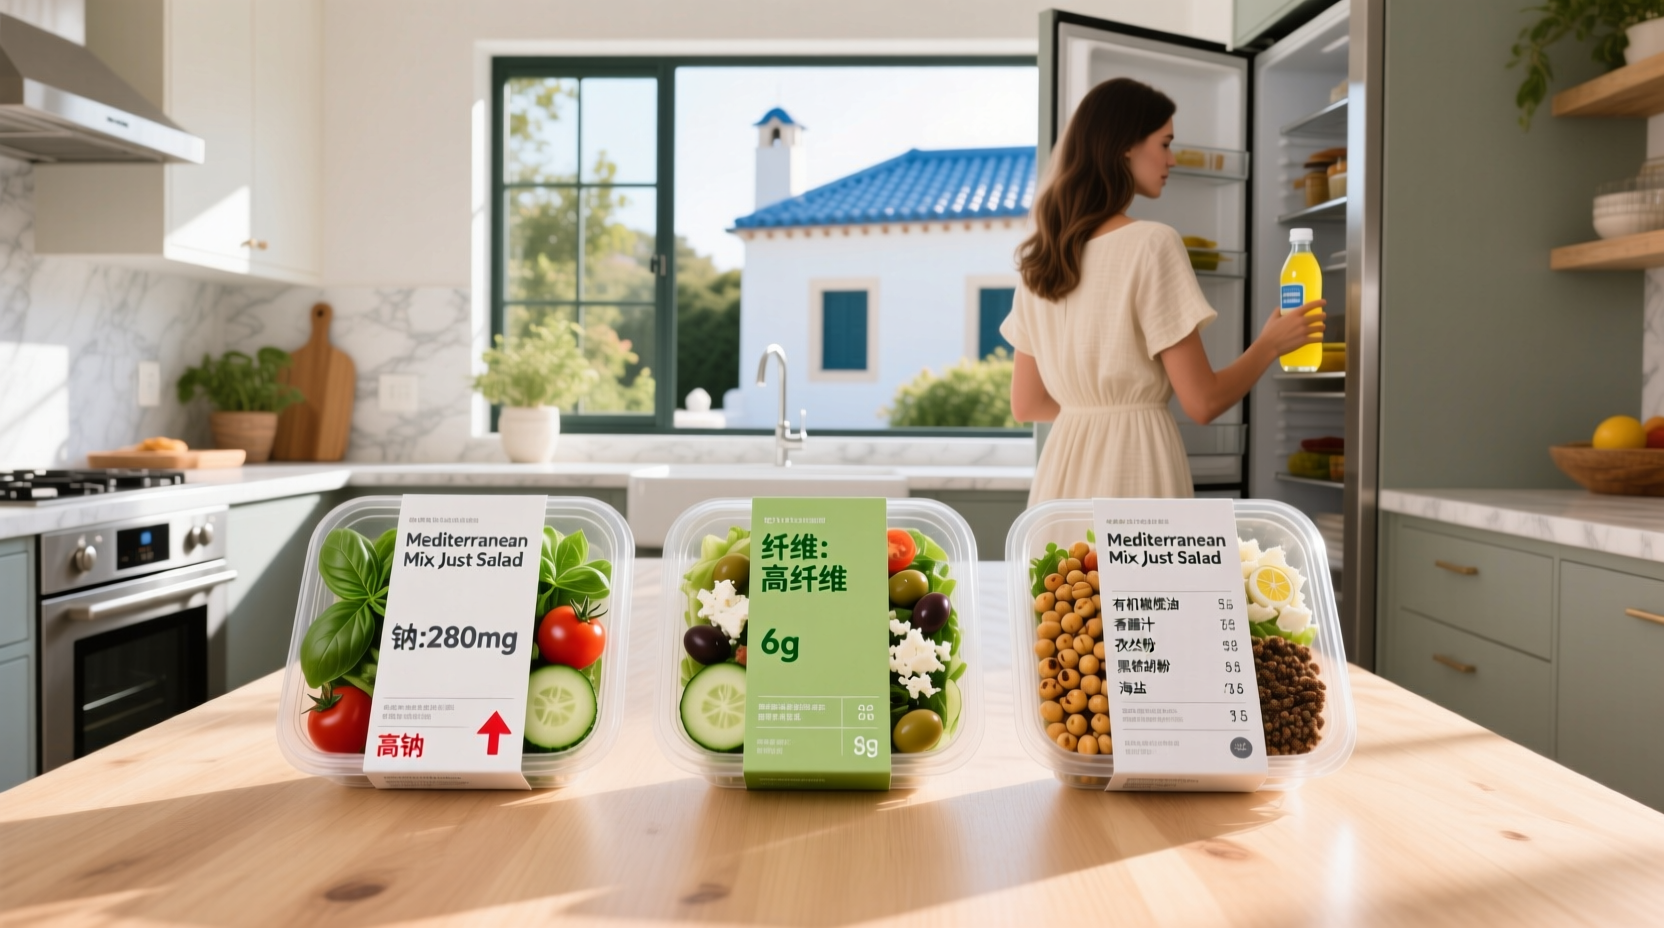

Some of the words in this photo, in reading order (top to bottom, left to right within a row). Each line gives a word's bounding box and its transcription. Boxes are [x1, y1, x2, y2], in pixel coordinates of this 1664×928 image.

[406, 531, 528, 548] Mediterranean
[1107, 531, 1227, 547] Mediterranean
[403, 551, 435, 567] Mix
[437, 551, 474, 570] Just
[476, 550, 524, 568] Salad
[1109, 550, 1139, 565] Mix
[1141, 550, 1174, 568] Just
[1177, 550, 1222, 565] Salad
[761, 563, 848, 593] 高纤维
[760, 628, 800, 663] 6g
[376, 732, 425, 759] 高钠
